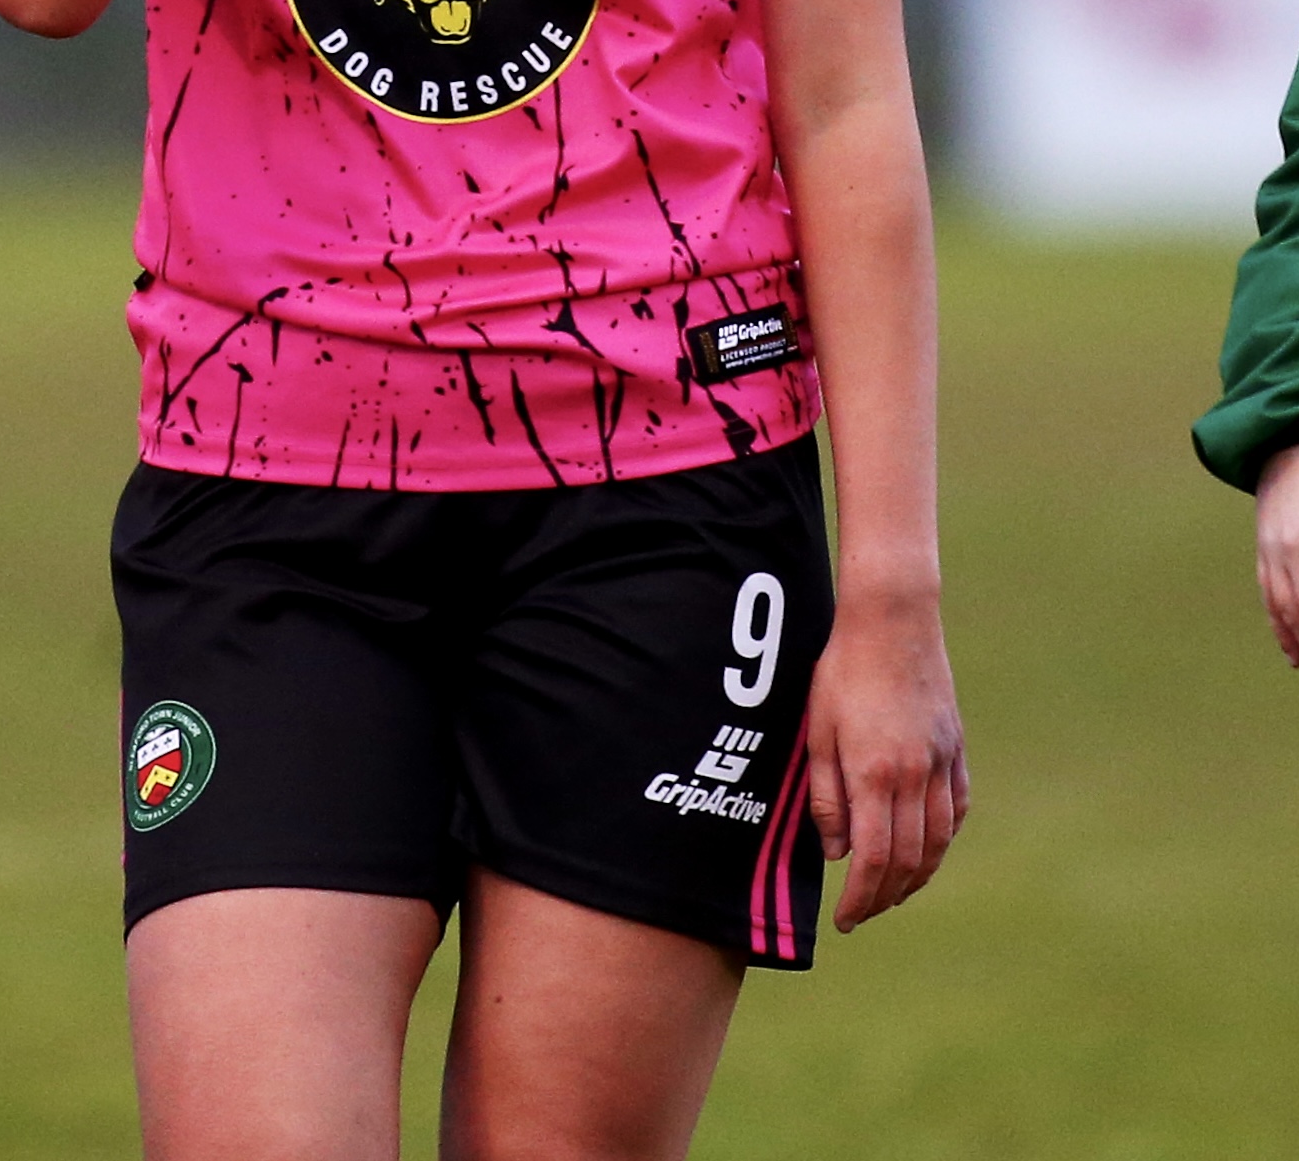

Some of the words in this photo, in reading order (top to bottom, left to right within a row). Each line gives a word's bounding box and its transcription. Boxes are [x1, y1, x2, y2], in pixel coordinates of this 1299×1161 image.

[318, 28, 394, 97] DOG
[420, 21, 574, 113] RESCUE
[722, 571, 786, 708] 9
[170, 782, 195, 808] CLUB
[644, 772, 767, 825] GripActive
